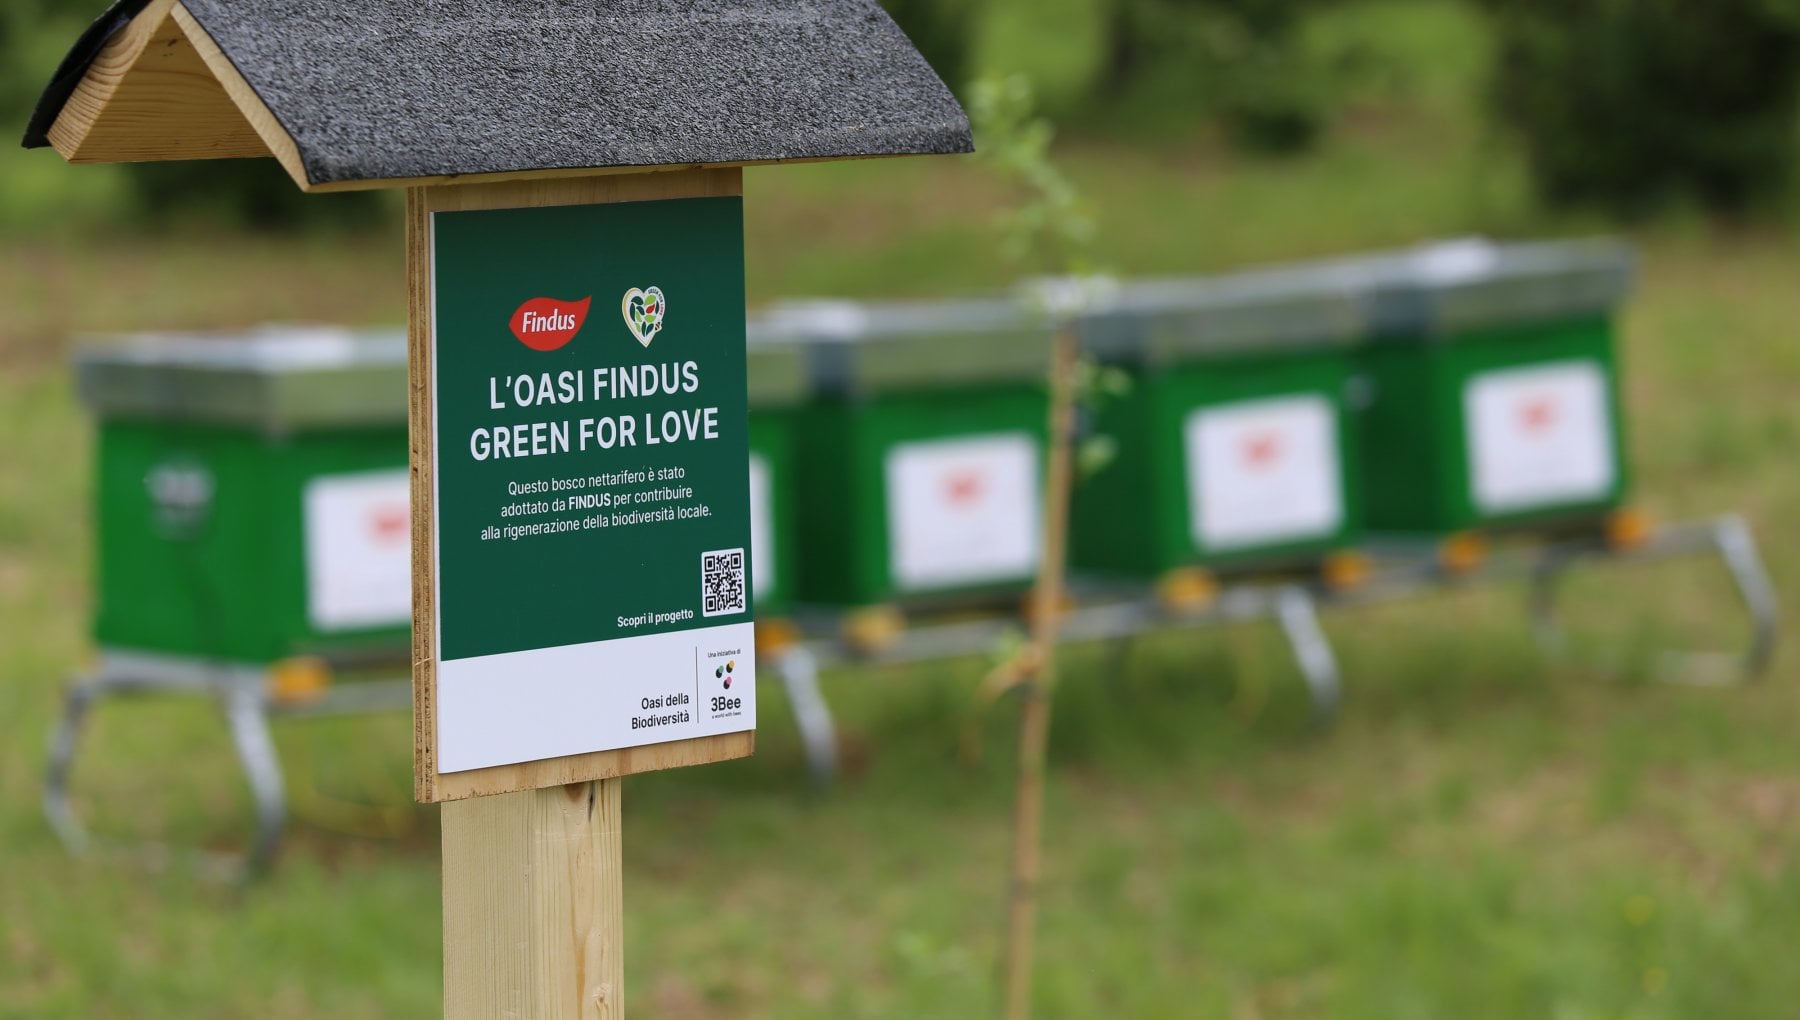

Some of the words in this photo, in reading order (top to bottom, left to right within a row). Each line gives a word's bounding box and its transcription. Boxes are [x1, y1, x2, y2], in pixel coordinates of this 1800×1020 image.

[522, 308, 576, 334] Findus
[490, 369, 584, 410] L'OASI
[593, 360, 699, 401] FINDUS
[470, 420, 570, 462] GREEN
[579, 415, 637, 452] FOR
[645, 407, 719, 445] LOVE
[508, 480, 549, 496] Questo
[551, 477, 586, 491] bosco
[588, 469, 645, 488] nettarifero
[647, 467, 655, 482] è
[657, 465, 685, 481] stato
[501, 500, 549, 517] adottato
[551, 498, 566, 512] da
[568, 492, 612, 510] FINDUS
[613, 493, 632, 509] per
[634, 484, 693, 503] contribuire
[480, 525, 501, 541] alla
[503, 518, 580, 541] rigenerazione
[582, 513, 609, 529] della
[611, 505, 675, 527] biodiversità
[677, 503, 712, 520] locale.
[617, 612, 647, 628] Scopri
[648, 611, 654, 624] il
[655, 608, 694, 626] progetto
[717, 649, 736, 657] iniziativa
[641, 694, 664, 710] Oasi
[665, 692, 689, 707] della
[711, 696, 742, 712] 3Bee
[631, 709, 690, 730] Biodiversità
